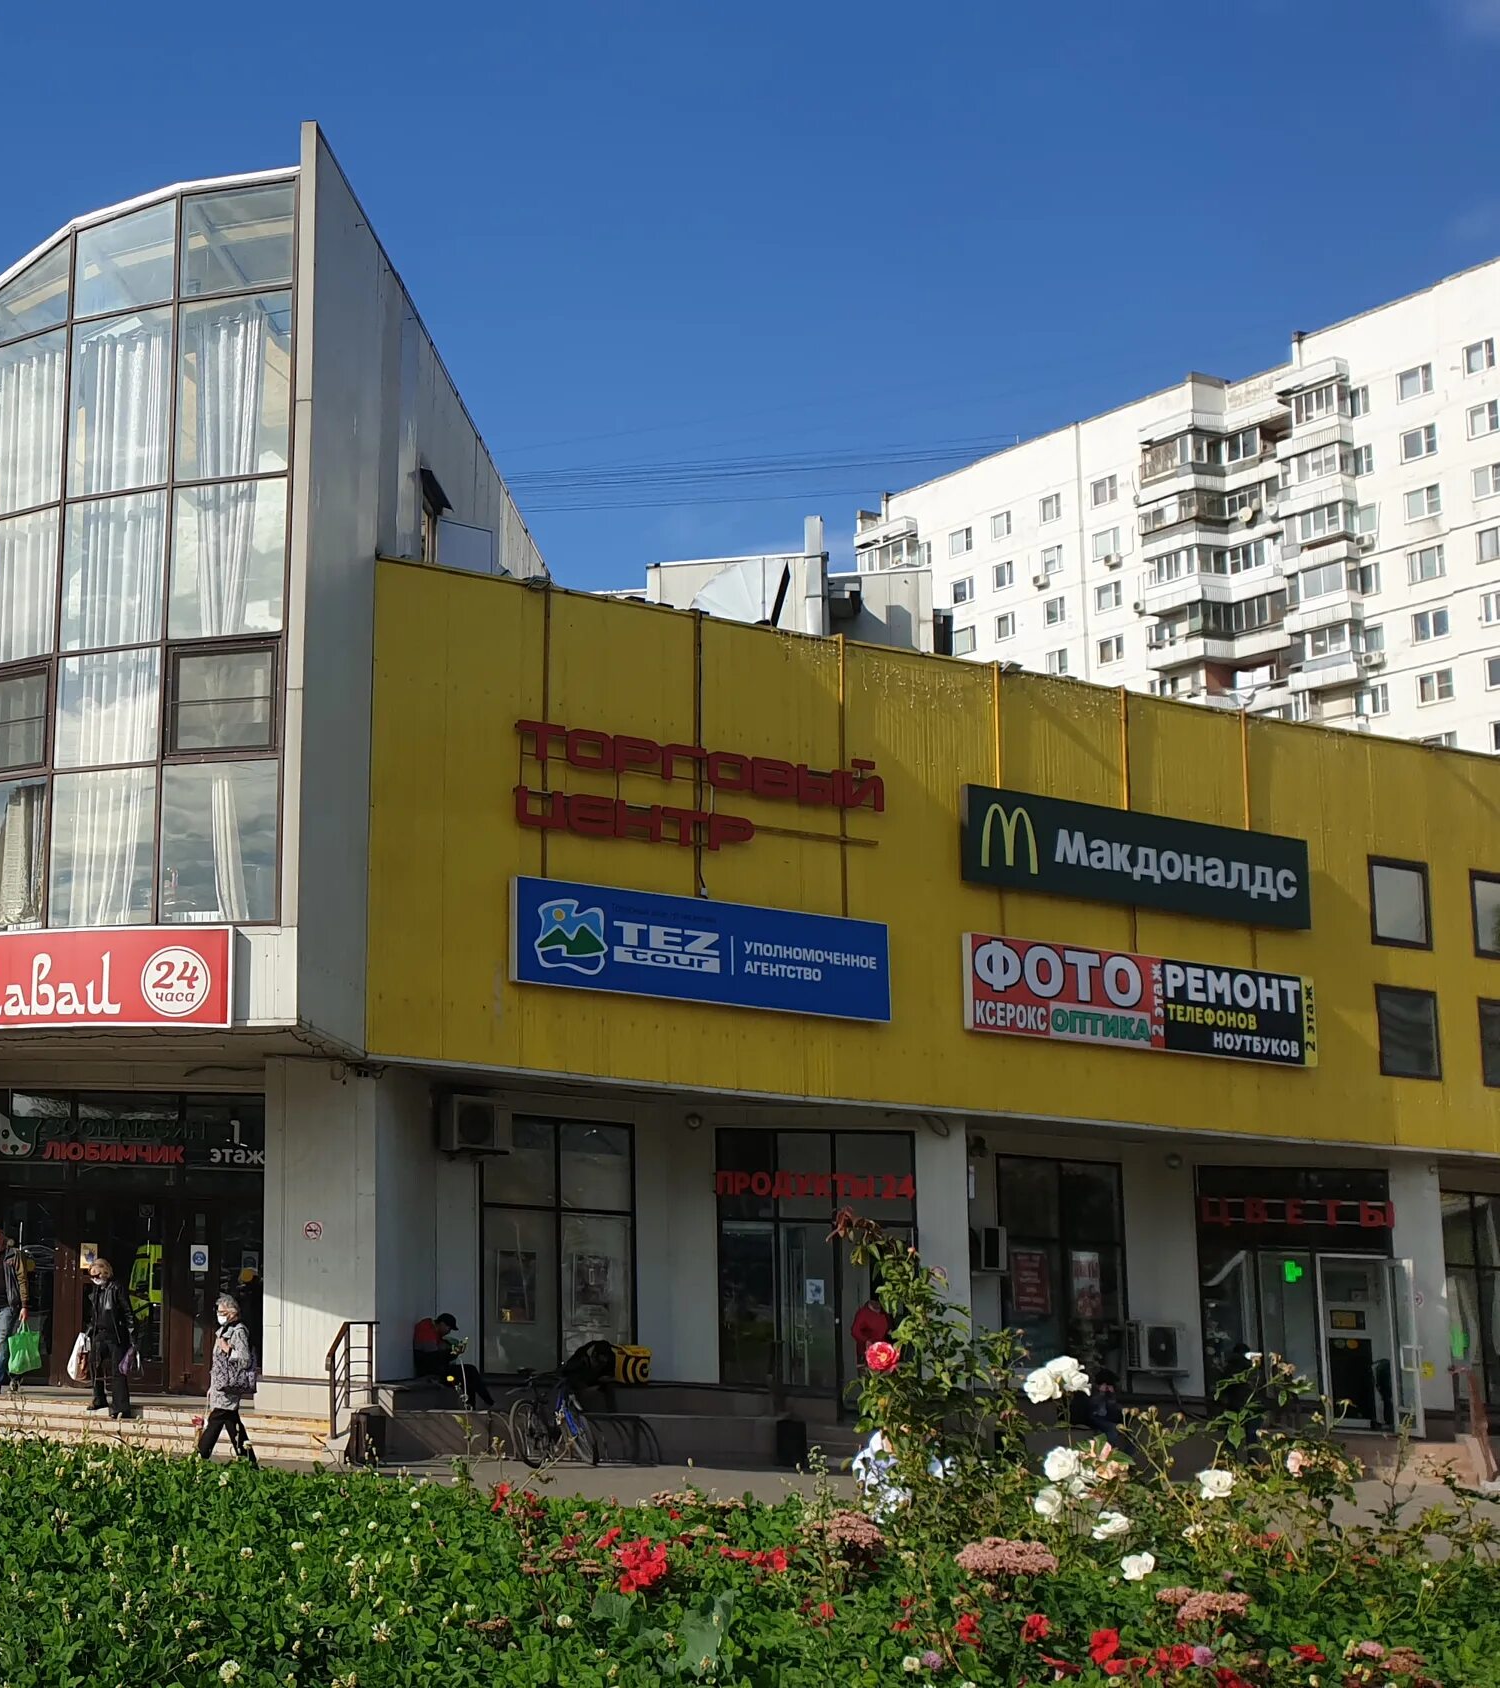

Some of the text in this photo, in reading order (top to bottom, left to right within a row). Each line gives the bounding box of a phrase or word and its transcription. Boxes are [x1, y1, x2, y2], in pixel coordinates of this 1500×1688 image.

[514, 719, 885, 812] ТОРГОВЫЙ
[513, 785, 755, 850] ЦЕНТР
[1054, 828, 1298, 901] Макдоналдс
[613, 920, 720, 956] TEZ
[624, 950, 709, 968] tour
[744, 941, 877, 970] УПОЛНОМОЧЕННОЕ
[744, 960, 822, 981] АГЕНТСТВО
[152, 960, 199, 990] 24
[973, 940, 1144, 1008] ФОТО
[1164, 963, 1300, 1014] РЕМОНТ
[155, 991, 195, 1003] часа
[1152, 962, 1165, 1037] 2 этаж
[975, 1000, 1047, 1031] КСЕРОКС
[1051, 1008, 1150, 1042] ОПТИКА
[1167, 1003, 1257, 1030] ТЕЛЕФОНОВ
[1304, 984, 1316, 1052] 2 этаж
[1213, 1032, 1300, 1058] НОУТБУКОВ
[43, 1140, 186, 1164] ЛЮБИМЧИК
[210, 1148, 265, 1164] этаж
[716, 1171, 916, 1200] ПРОДУКТЫ 24
[1202, 1196, 1396, 1229] ЦВЕТЫ
